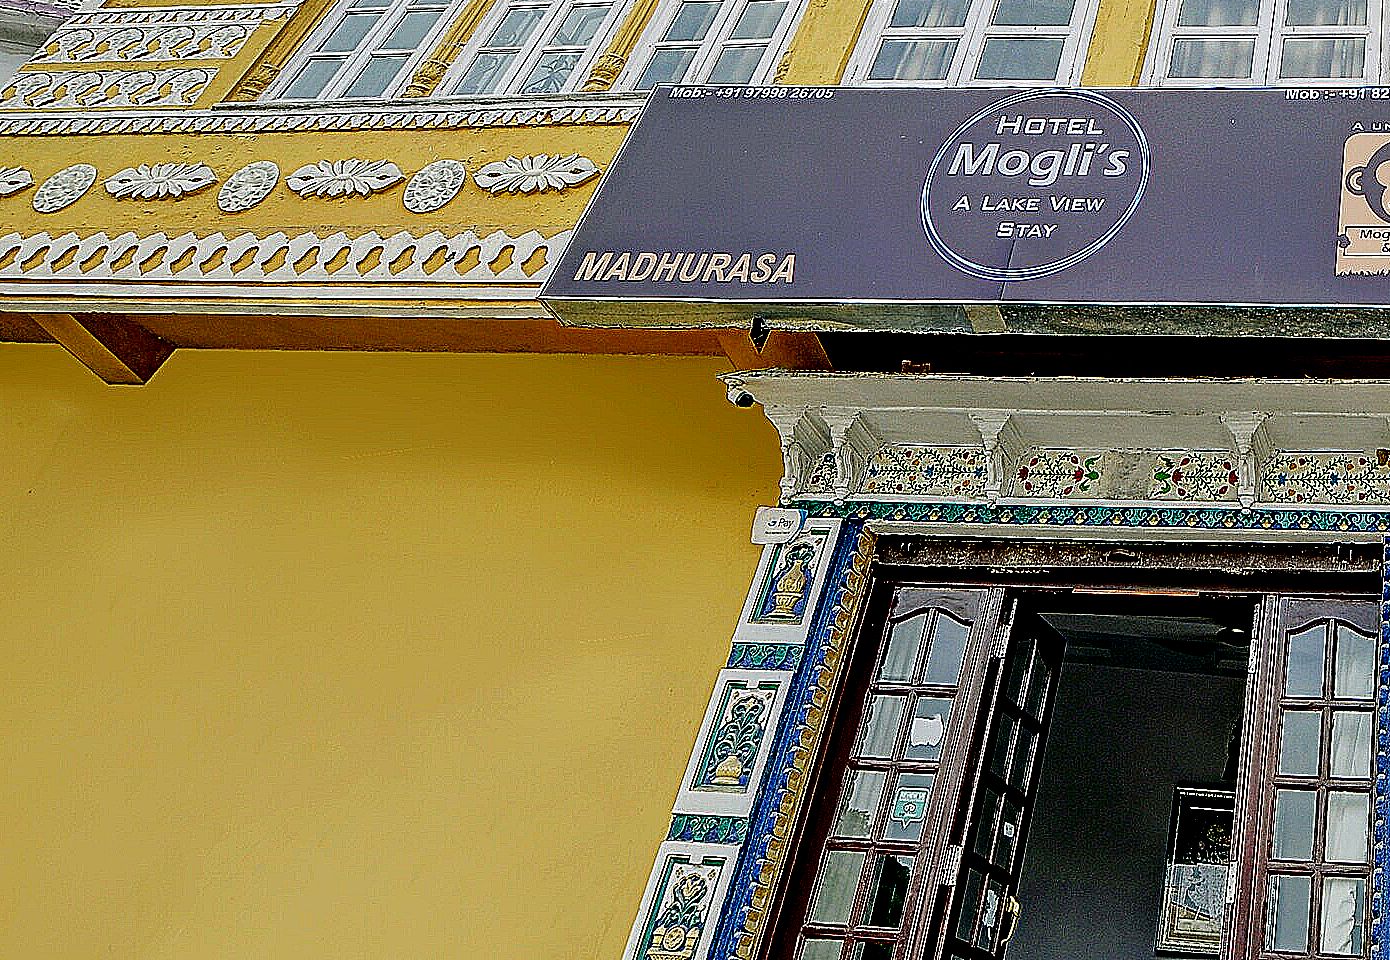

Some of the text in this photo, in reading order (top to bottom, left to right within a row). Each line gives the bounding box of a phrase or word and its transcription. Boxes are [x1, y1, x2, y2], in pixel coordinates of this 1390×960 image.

[715, 87, 743, 99] +91
[789, 88, 834, 100] 26705
[1285, 88, 1320, 100] Mob
[1339, 88, 1366, 100] +91
[1352, 122, 1365, 131] A
[947, 142, 1131, 187] Mogli's
[952, 195, 971, 211] A
[573, 252, 796, 283] MADHURASA
